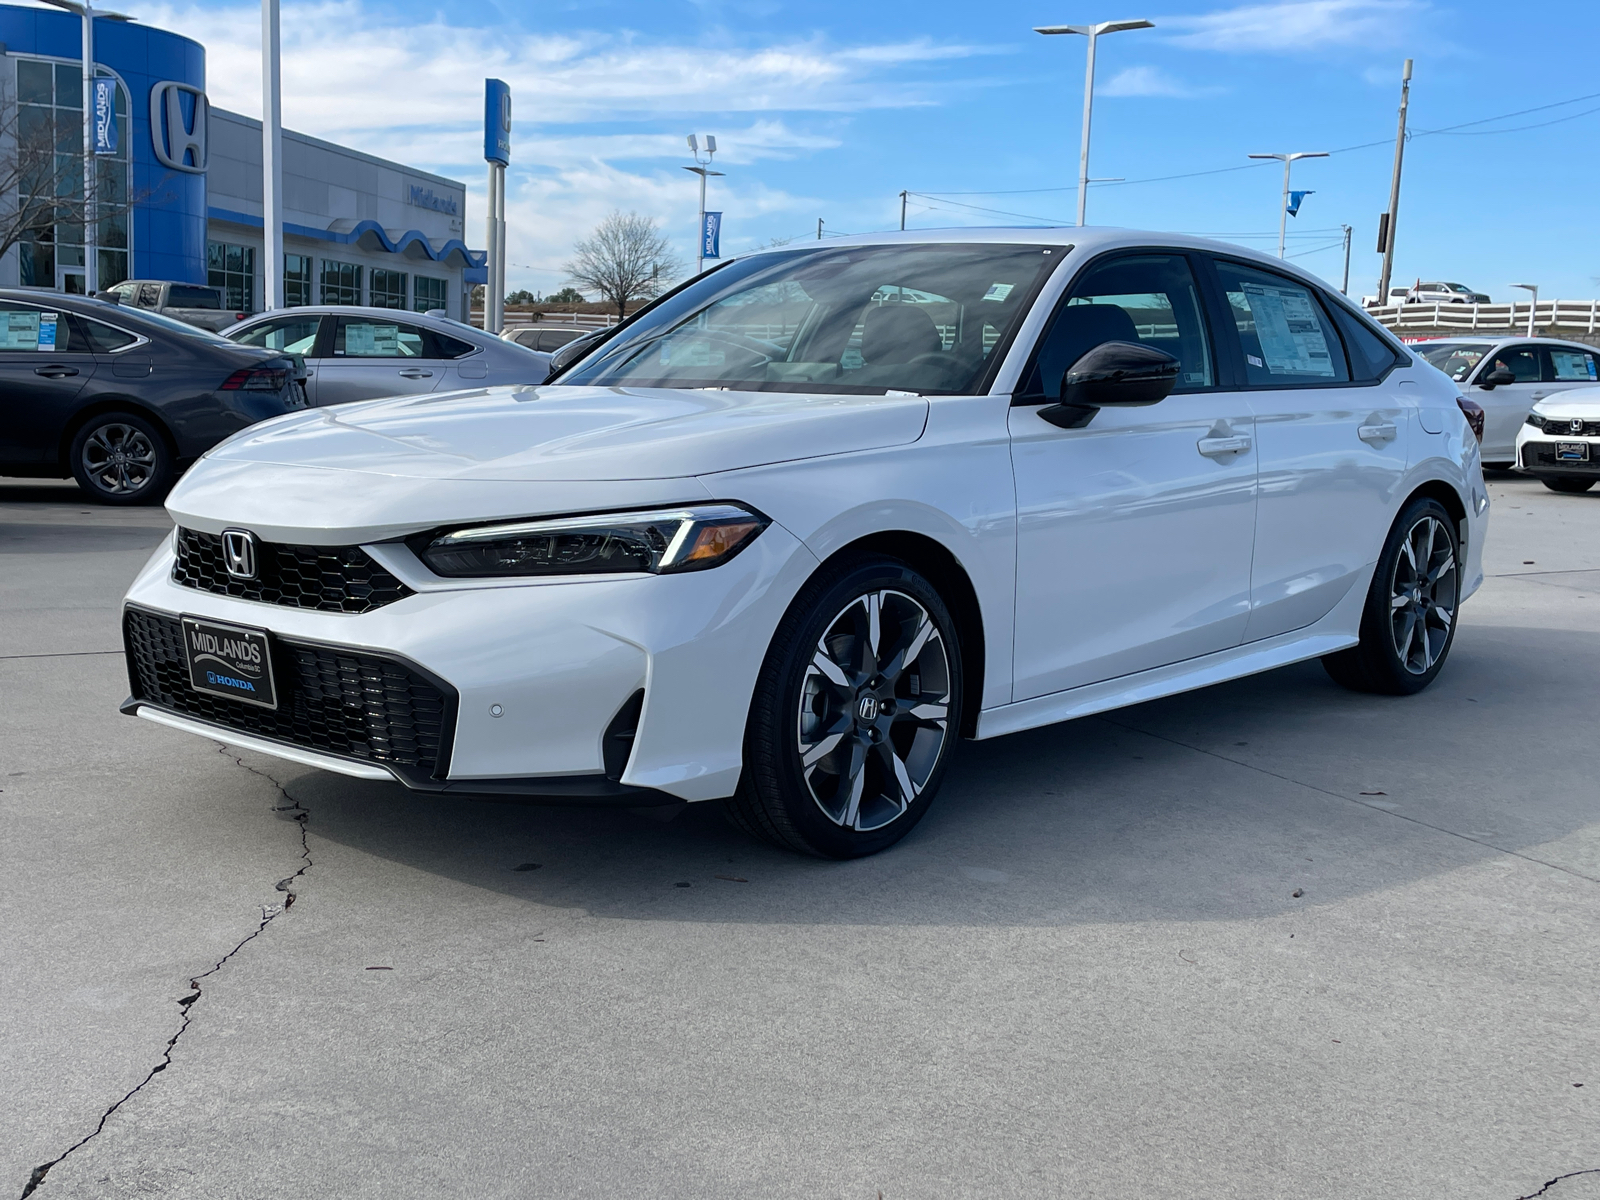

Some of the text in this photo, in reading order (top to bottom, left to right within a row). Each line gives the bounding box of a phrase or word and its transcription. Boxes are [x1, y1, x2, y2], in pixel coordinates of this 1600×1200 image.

[97, 83, 107, 147] MIDLANDS
[410, 184, 457, 216] Midlands
[705, 215, 714, 254] MIDLANDS
[191, 631, 260, 663] MIDLANDS
[216, 674, 256, 692] HONDA
